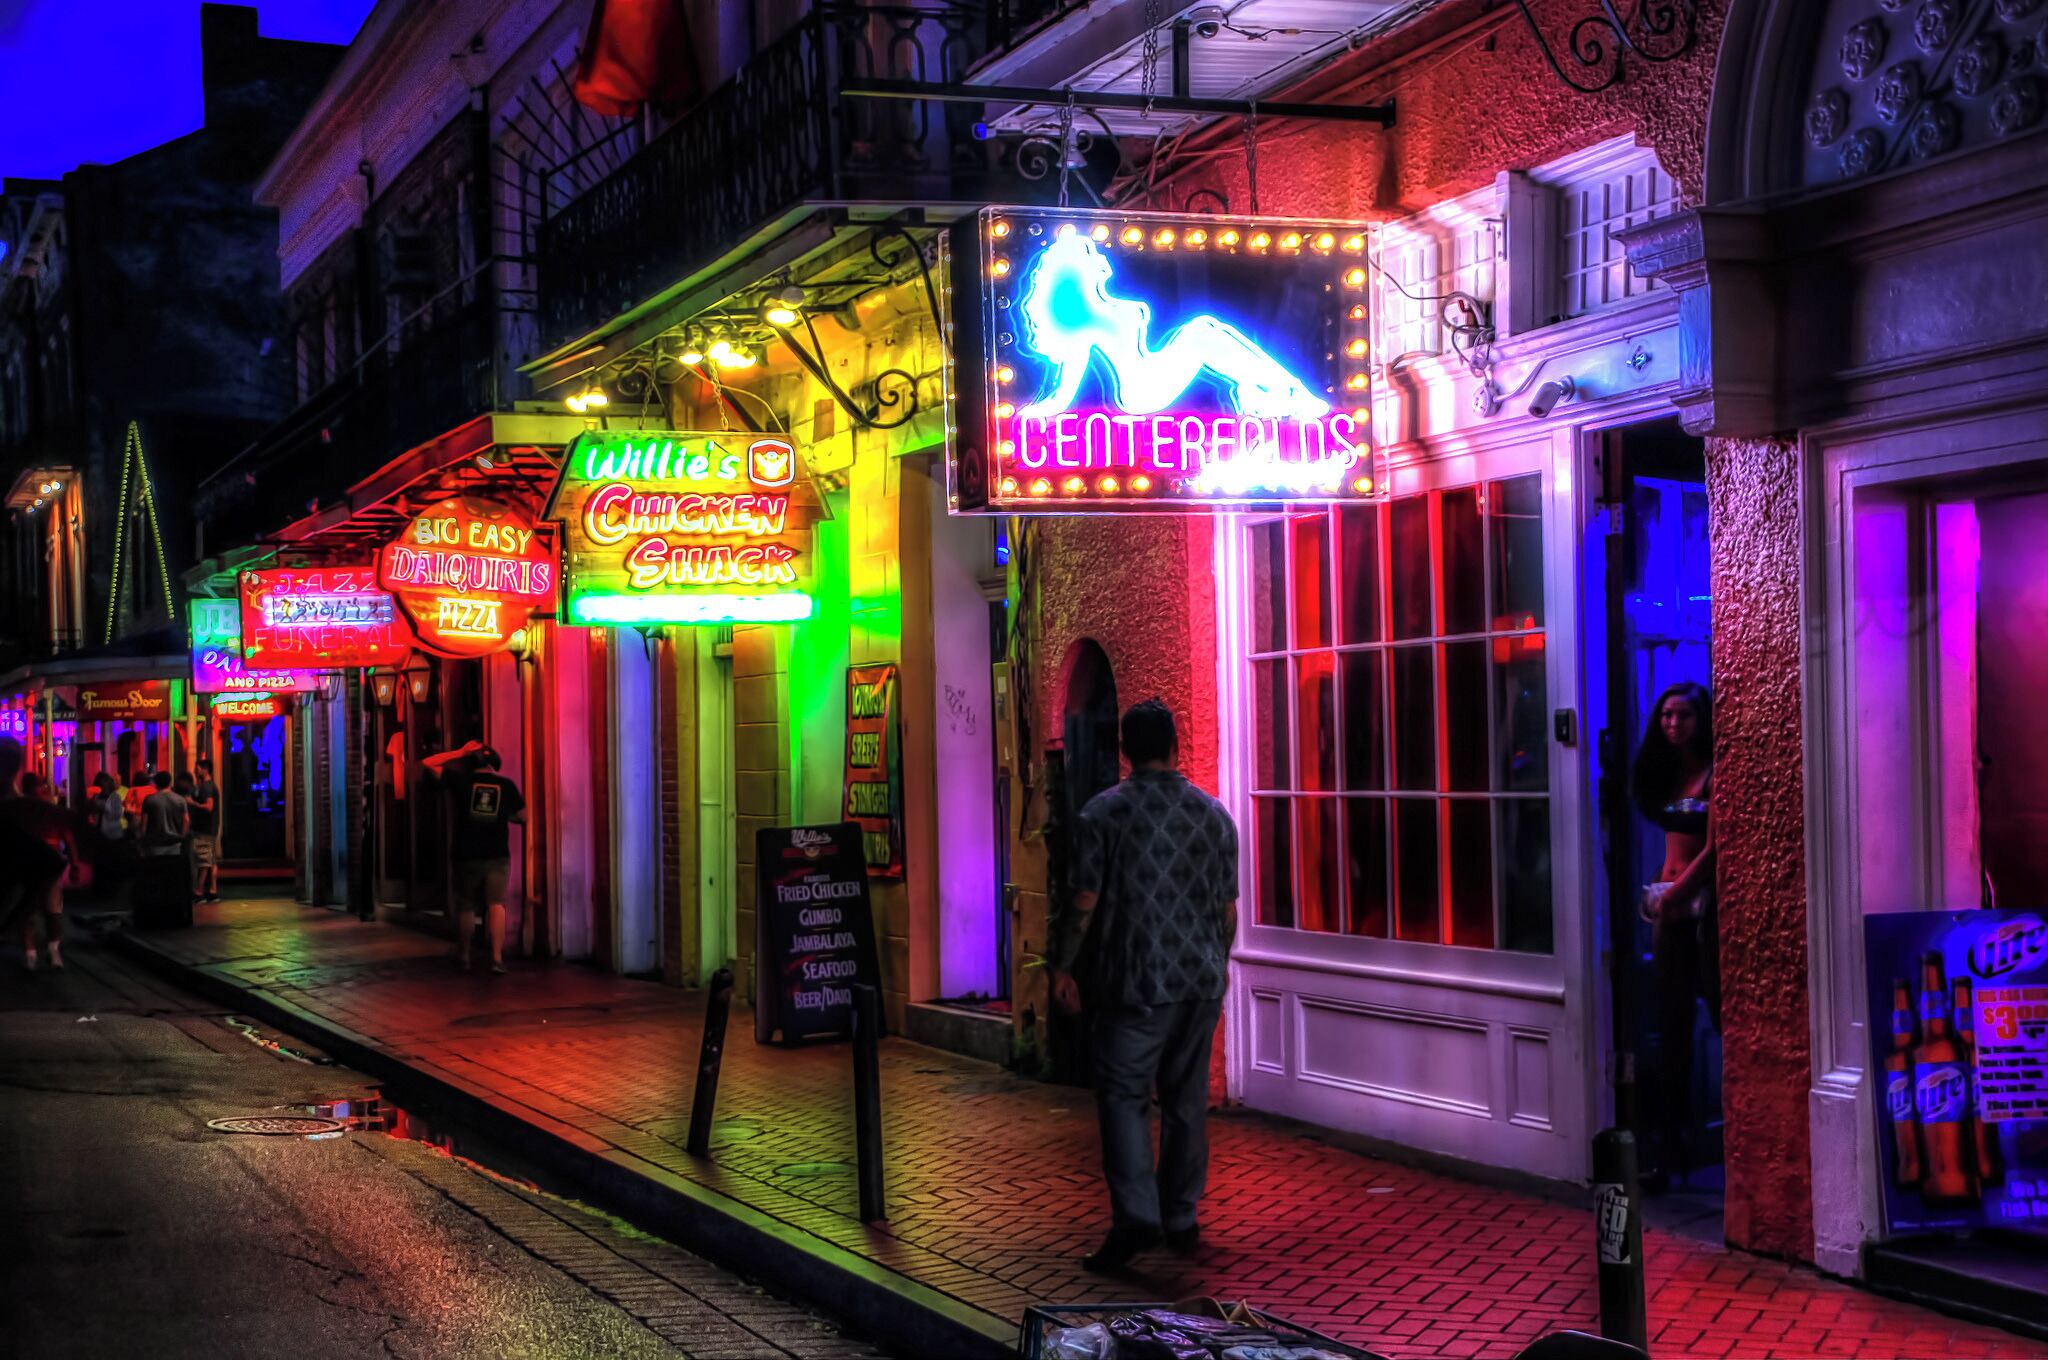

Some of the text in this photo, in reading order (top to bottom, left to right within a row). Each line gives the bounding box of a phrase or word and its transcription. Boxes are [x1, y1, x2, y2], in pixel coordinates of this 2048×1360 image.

[586, 440, 741, 481] Willie's
[416, 517, 533, 555] BIG EASY
[388, 545, 551, 595] DAIQUIRIS
[273, 572, 376, 595] JAZZ
[438, 601, 498, 633] PIZZA
[254, 626, 405, 651] FUNERAL
[225, 675, 295, 688] AND PIZZA
[82, 689, 163, 711] Famous Door
[216, 702, 275, 715] WELCOME
[777, 881, 861, 903] FRIED CHICKEN
[798, 907, 842, 926] GUMBO
[789, 931, 857, 953] JAMBALAYA
[802, 959, 857, 981] SEAFOOD
